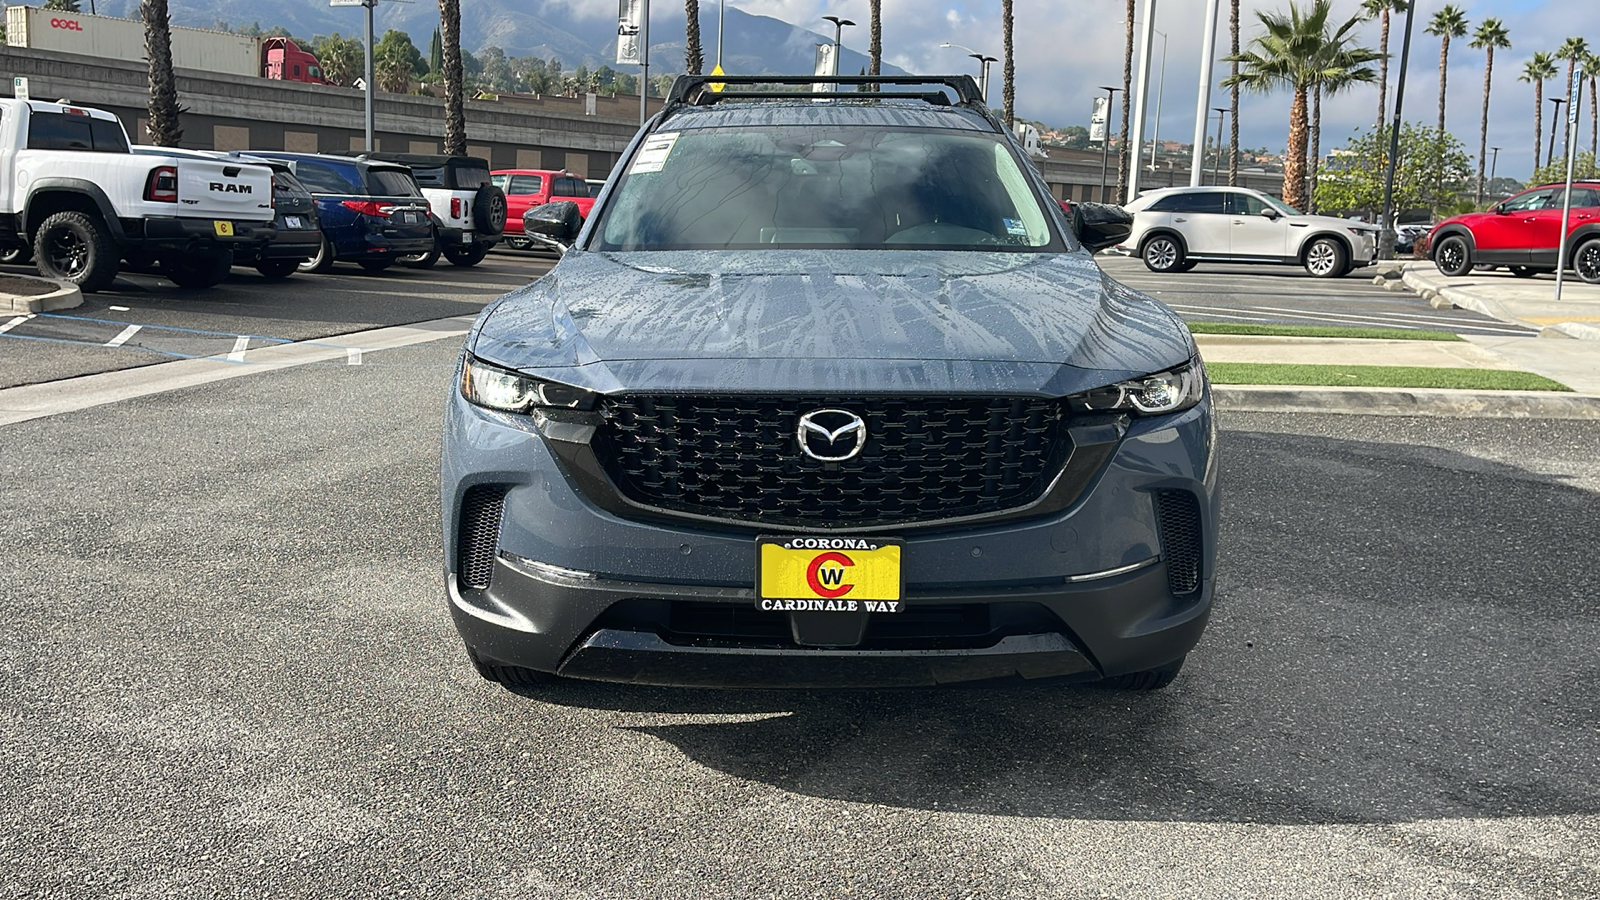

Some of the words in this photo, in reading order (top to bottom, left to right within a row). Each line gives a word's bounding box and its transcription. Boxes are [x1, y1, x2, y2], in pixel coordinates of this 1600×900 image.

[50, 18, 83, 31] OOCL
[209, 182, 252, 194] RAM
[792, 538, 869, 550] CORONA
[762, 599, 858, 611] CARDINALE
[864, 601, 899, 612] WAY
